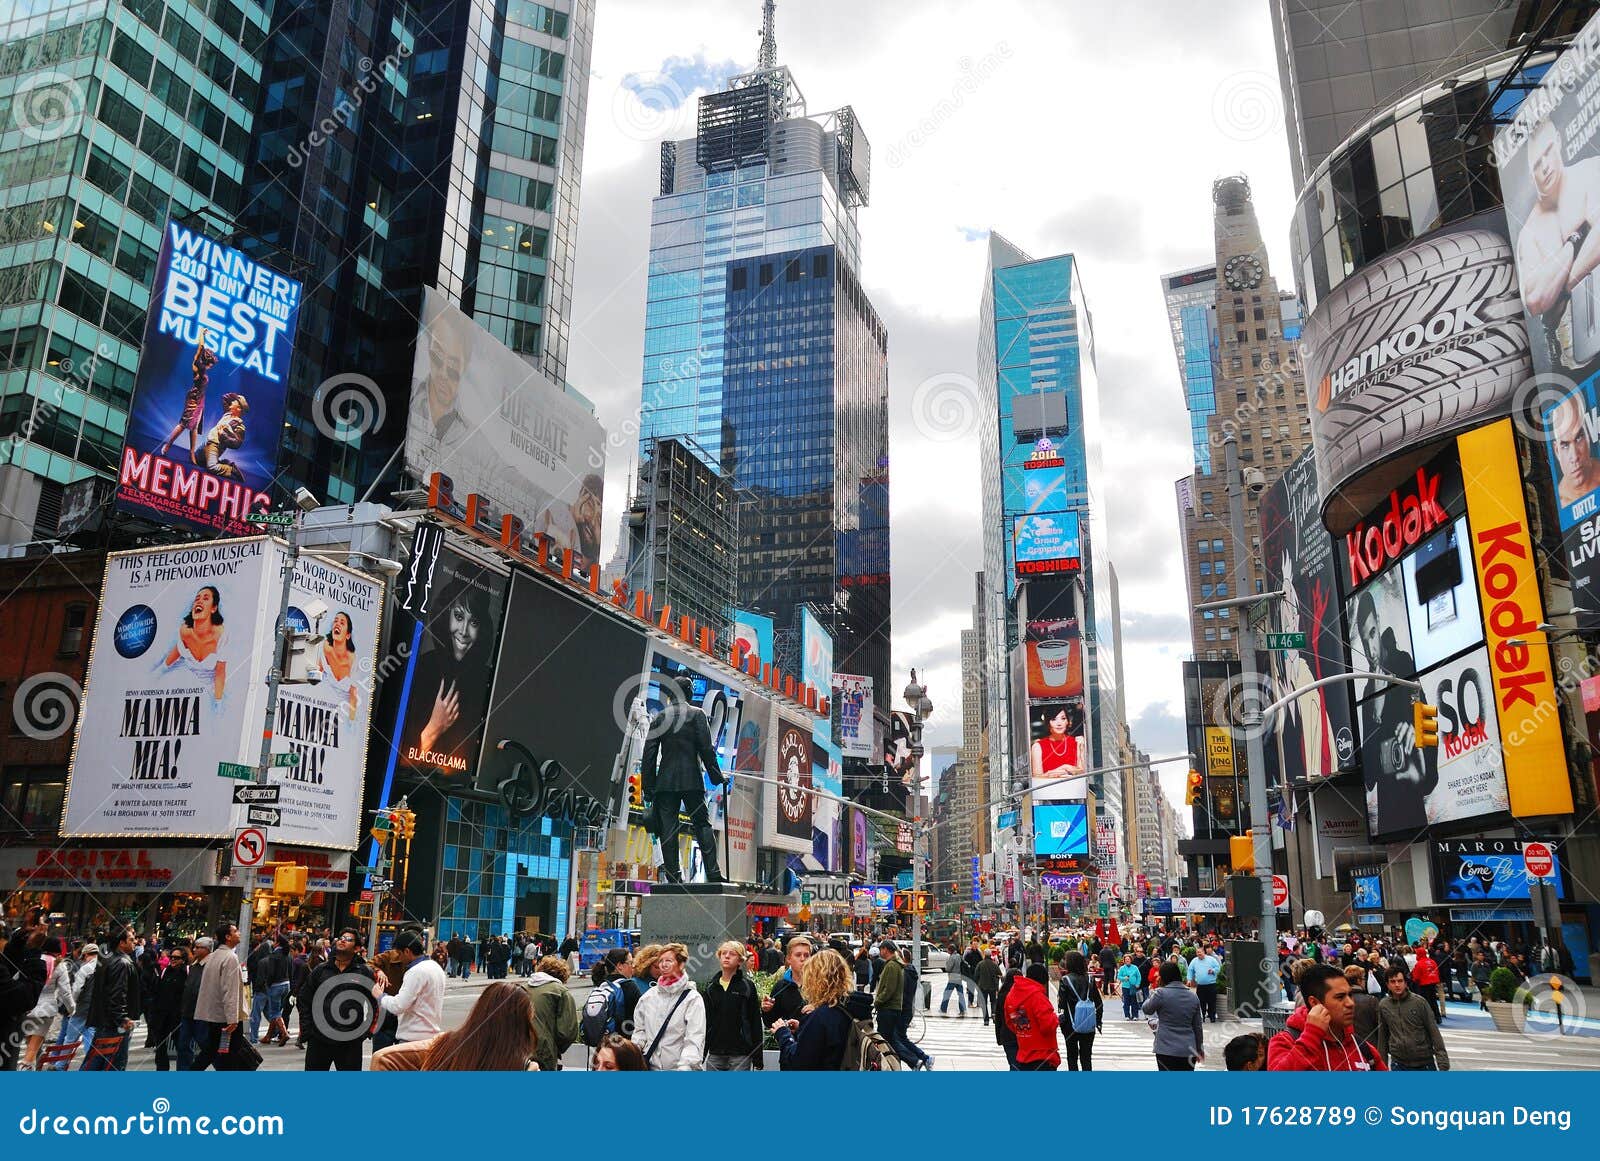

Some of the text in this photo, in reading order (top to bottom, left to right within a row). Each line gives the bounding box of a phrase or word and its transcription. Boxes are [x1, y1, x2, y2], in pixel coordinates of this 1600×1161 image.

[170, 221, 298, 306] WINNER!
[171, 252, 290, 320] 2010 TONY AWARD
[163, 270, 287, 356] BEST
[159, 311, 281, 382] MUSICAL
[1350, 330, 1487, 399] driving emotion
[501, 391, 569, 462] DUE DATE
[510, 431, 557, 472] NOVEMBER 5
[1025, 459, 1064, 469] TOSHIBA
[1031, 450, 1057, 460] 2010
[123, 487, 201, 516] TELECHARGE.COM
[1572, 494, 1597, 521] ORTIZ
[249, 514, 289, 524] LAMAR
[1346, 467, 1449, 587] Kodak
[211, 542, 263, 560] MUSICAL
[130, 559, 243, 583] IS A PHENOMENON!"
[1017, 559, 1080, 573] TOSHIBA
[303, 561, 373, 598] WORLD'S MOST
[117, 617, 155, 633] WORLDWIDE
[1479, 520, 1547, 712] Kodak
[1270, 636, 1277, 647] W
[1281, 635, 1292, 648] 46
[1437, 668, 1486, 736] SO
[120, 697, 200, 737] MAMMA
[276, 698, 339, 748] MAMMA
[782, 733, 806, 763] EARL OF
[1444, 717, 1489, 759] Kodak
[130, 738, 181, 780] MIA!
[285, 742, 326, 785] MIA!
[408, 747, 467, 771] BLACKGLAMA
[1210, 746, 1229, 756] LION
[220, 763, 242, 777] TIMES
[1211, 759, 1230, 769] KING
[1448, 779, 1461, 789] SHARE
[1462, 777, 1473, 787] YOUR
[1480, 771, 1495, 783] KODAK
[1457, 783, 1488, 796] MOMENT HERE
[240, 790, 274, 798] ONE WAY
[253, 812, 262, 820] ONE
[1324, 820, 1359, 829] Marriott
[35, 849, 153, 867] DIGITAL
[1439, 841, 1559, 853] MARQUS
[1043, 876, 1083, 886] YAHOO!
[1459, 860, 1492, 882] Come
[1486, 856, 1515, 881] Fly
